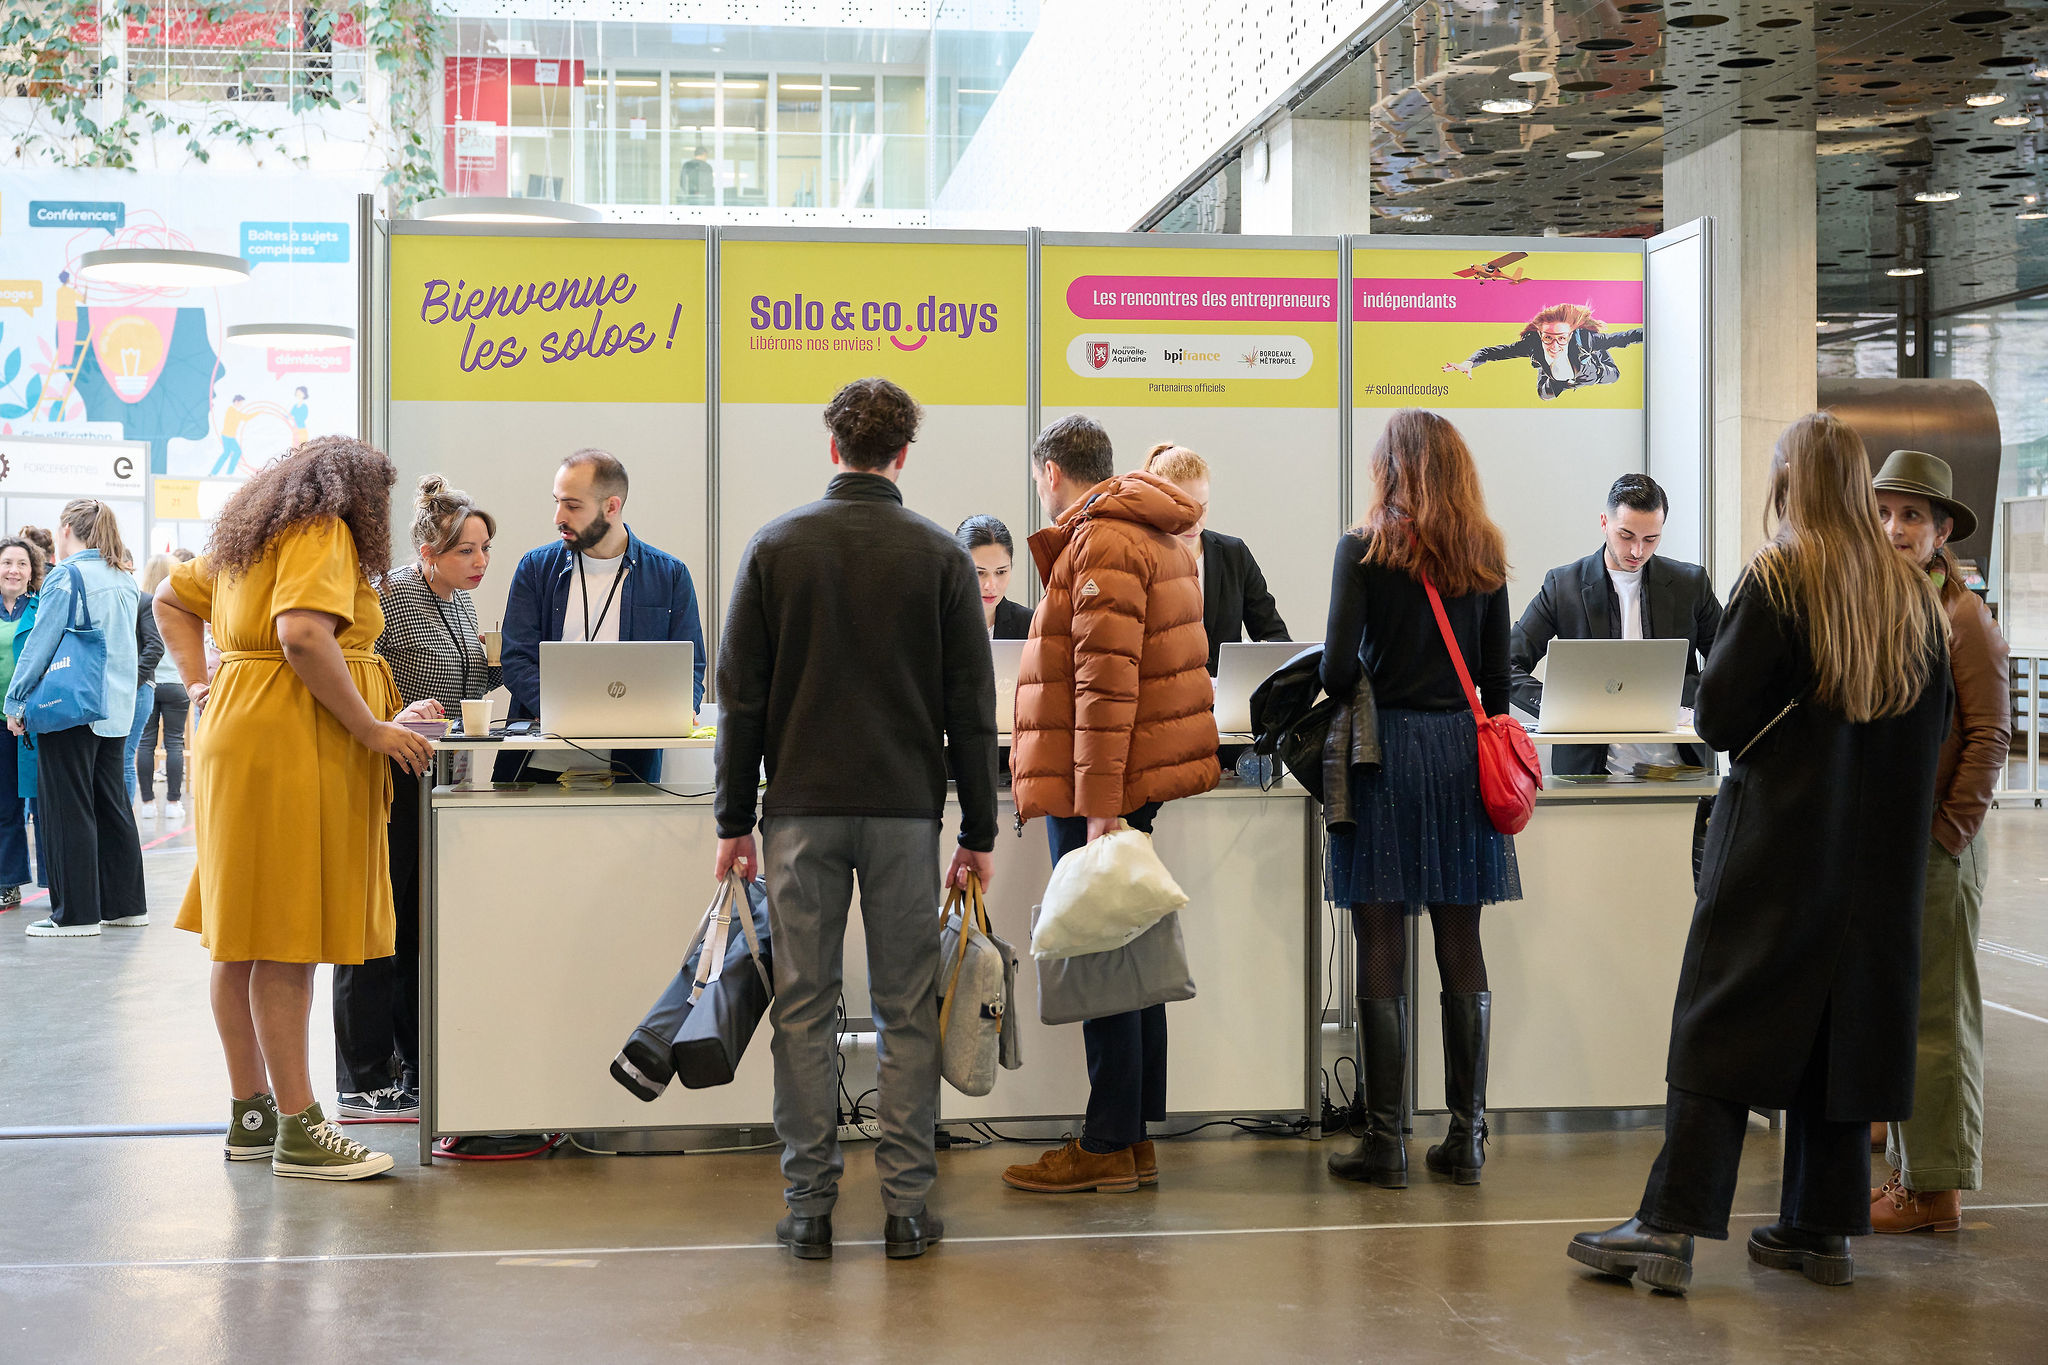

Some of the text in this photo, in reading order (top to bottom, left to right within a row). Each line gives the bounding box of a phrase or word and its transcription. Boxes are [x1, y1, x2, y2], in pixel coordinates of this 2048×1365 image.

[37, 208, 117, 221] Conférences
[248, 230, 339, 245] Boîtes à sujets
[247, 243, 316, 256] complexes
[421, 273, 637, 324] Bienvenue
[1093, 290, 1331, 310] Les rencontres des entrepreneurs
[1363, 291, 1457, 310] indépendants
[750, 294, 824, 331] Solo
[831, 301, 855, 331] &
[460, 323, 527, 372] les
[540, 308, 656, 363] solos
[750, 336, 803, 351] Libérons
[807, 339, 829, 351] nos
[833, 337, 873, 351] envies
[1111, 355, 1147, 364] Aquitaine
[1164, 348, 1221, 365] bpifrance
[1259, 356, 1296, 364] MÉTROPOLE
[1149, 382, 1226, 394] Partenaires officiels
[1364, 383, 1449, 397] #soloandcodays
[608, 681, 627, 699] hp
